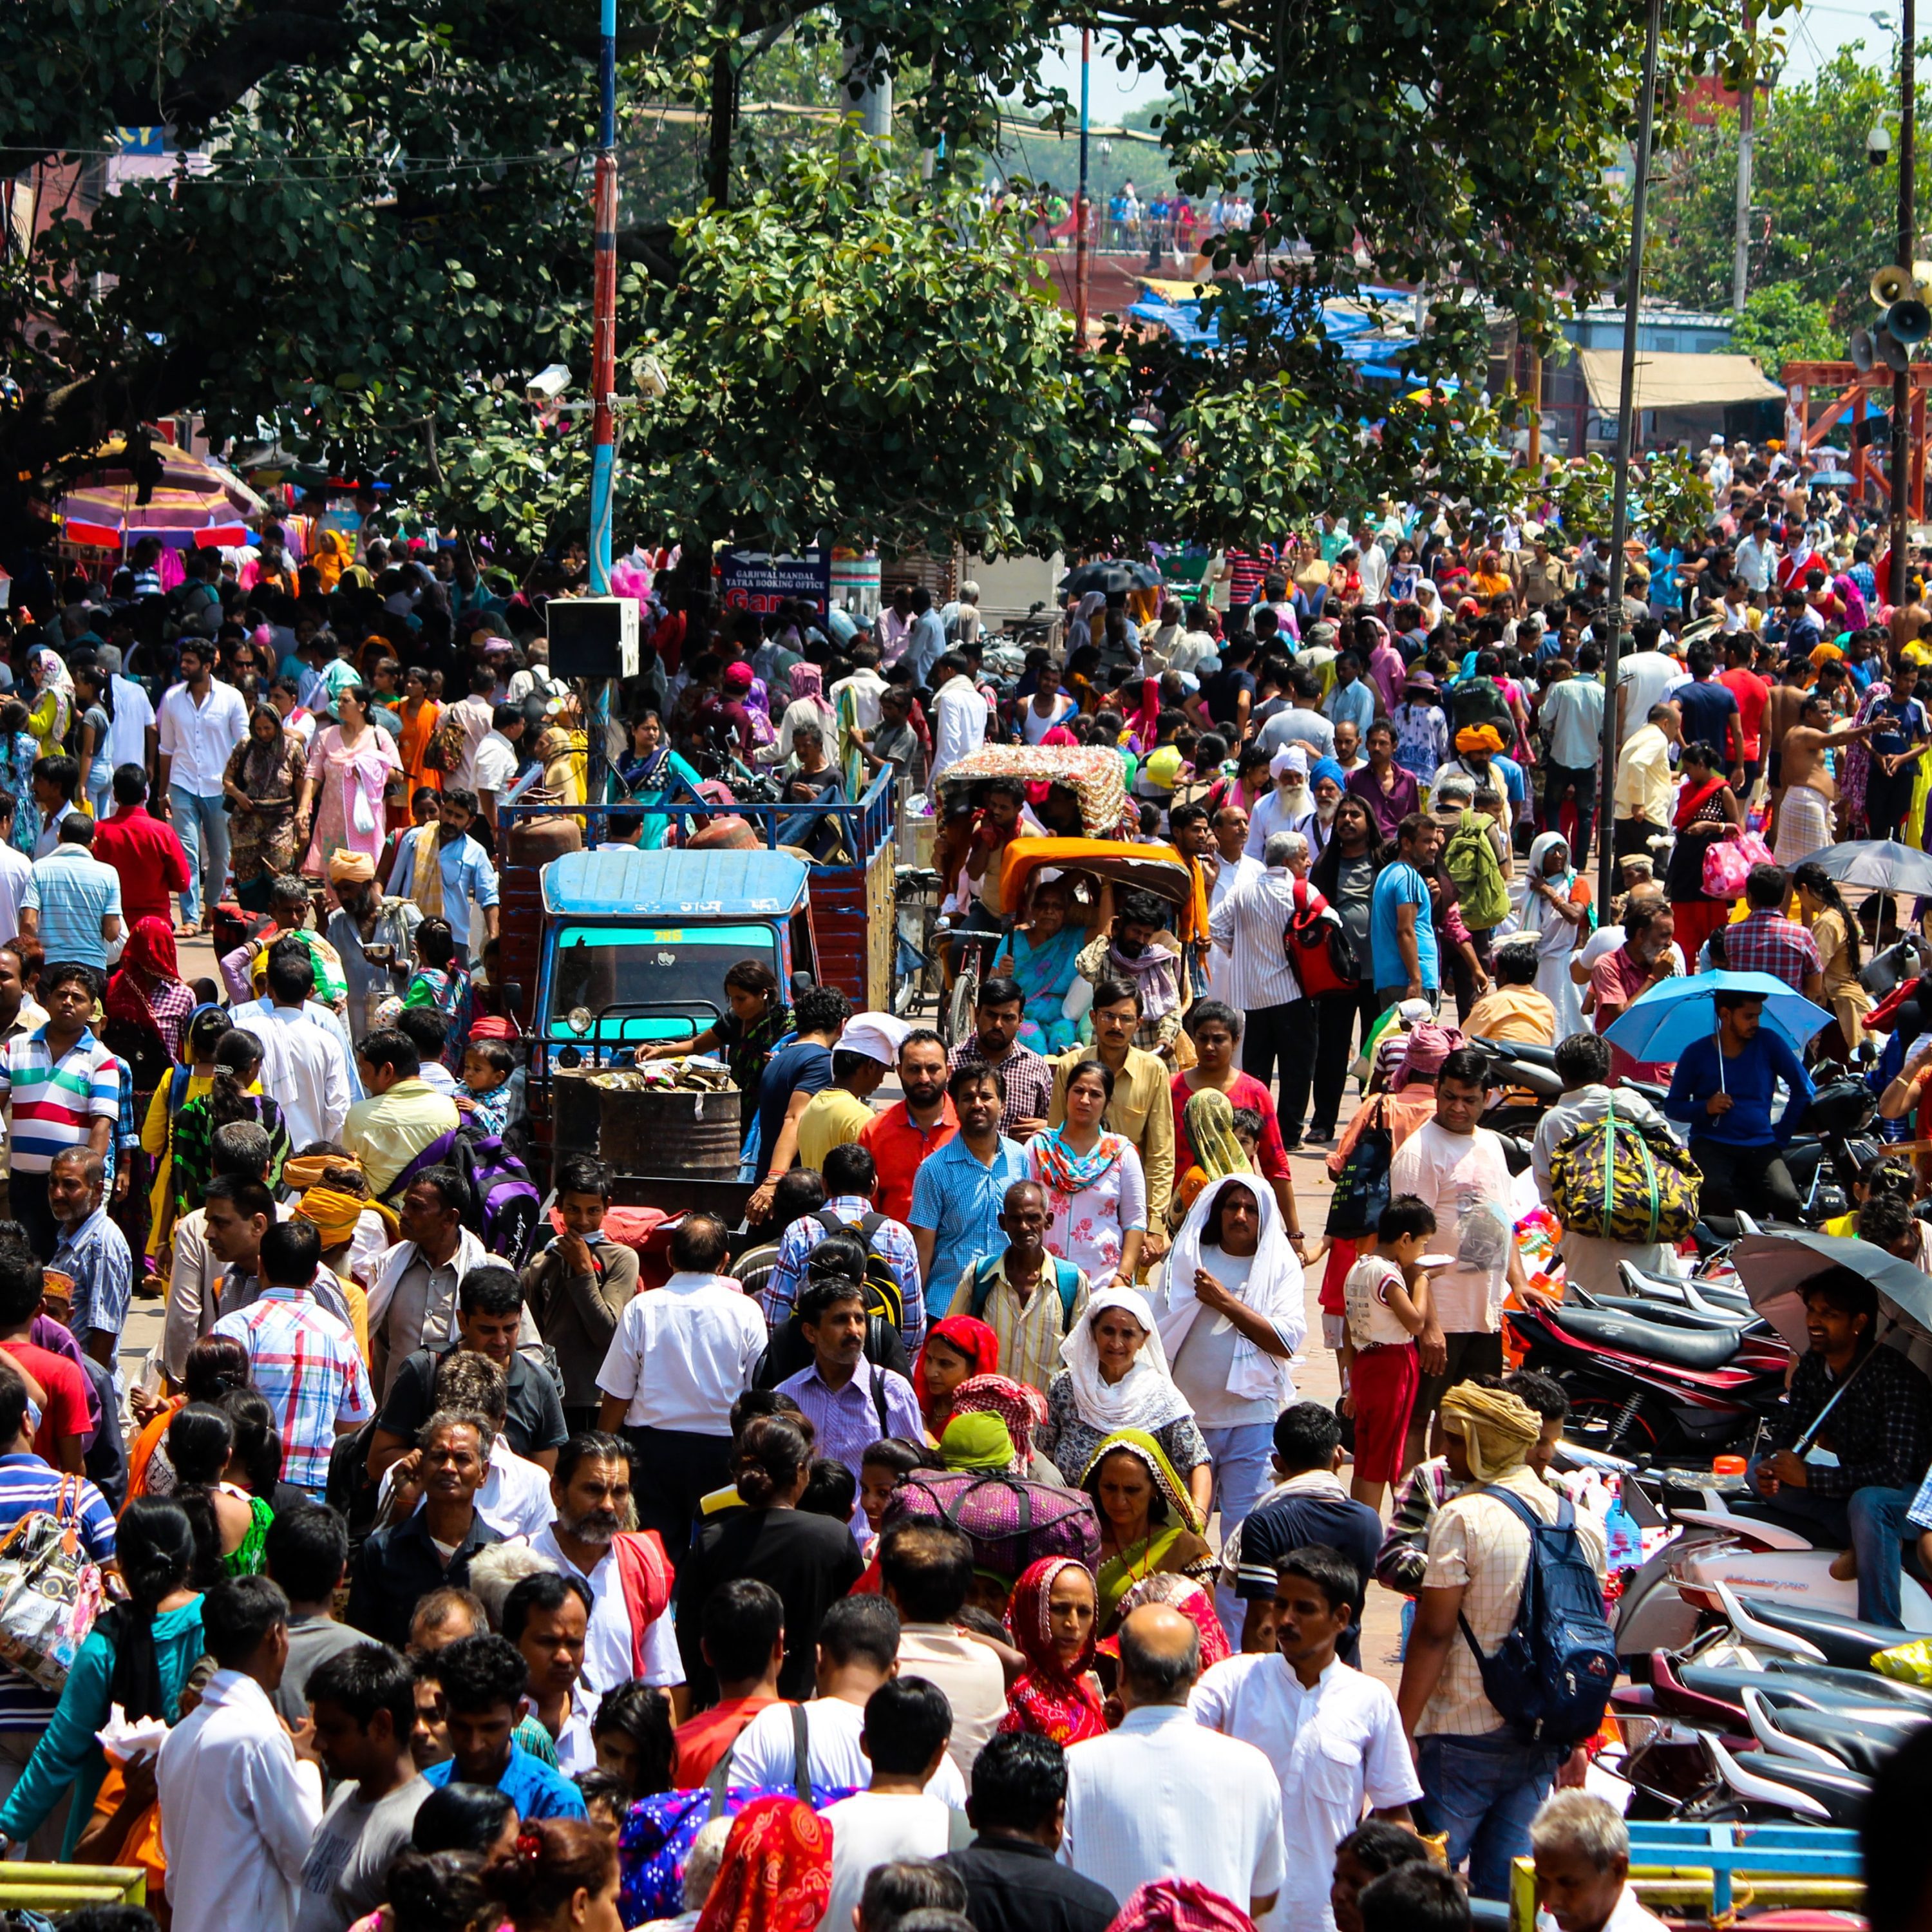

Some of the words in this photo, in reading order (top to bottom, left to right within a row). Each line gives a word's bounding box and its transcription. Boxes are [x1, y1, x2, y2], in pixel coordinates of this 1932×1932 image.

[736, 570, 777, 580] GARHWAL
[779, 572, 815, 580] MANDAL
[726, 578, 754, 587] YATRA
[755, 580, 793, 588] BOOKING
[795, 581, 825, 589] OFFICE
[654, 929, 682, 942] 786
